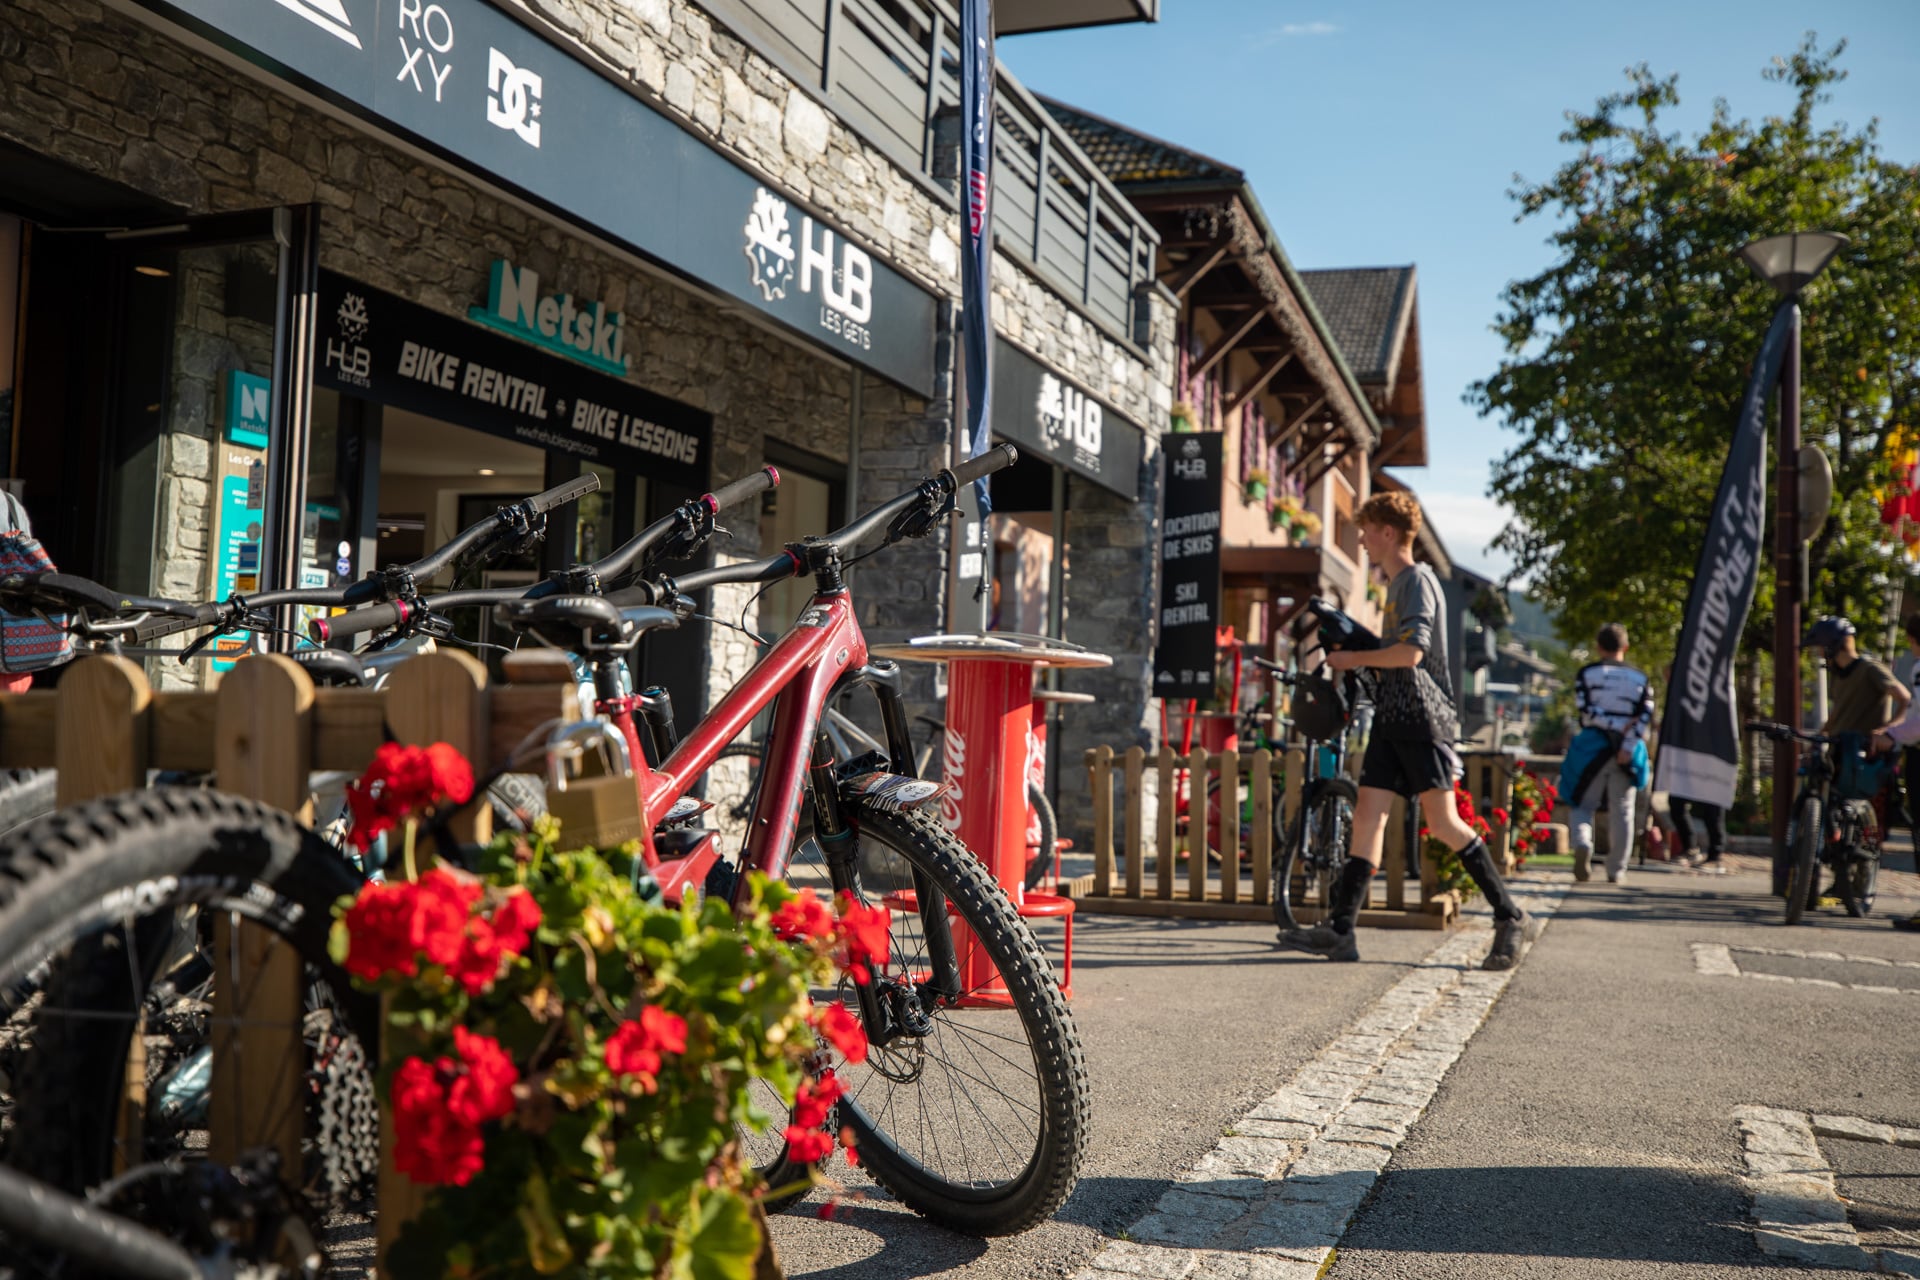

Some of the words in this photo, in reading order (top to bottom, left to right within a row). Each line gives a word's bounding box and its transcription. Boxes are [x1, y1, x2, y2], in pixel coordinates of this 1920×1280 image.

[487, 46, 542, 149] DC
[800, 216, 872, 324] HUB
[820, 306, 841, 333] LES
[843, 319, 871, 350] GETS
[325, 337, 371, 377] HUB
[337, 370, 351, 383] LES
[352, 375, 371, 389] GETS
[397, 340, 460, 391] BIKE
[461, 362, 548, 420] RENTAL
[571, 398, 619, 440] BIKE
[619, 414, 699, 464] LESSONS
[1064, 386, 1102, 455] HUB
[1163, 511, 1219, 537] OCATION
[1164, 540, 1180, 559] DE
[1183, 534, 1213, 556] SKIS
[1176, 582, 1198, 602] SKI
[1163, 602, 1209, 626] RENTAL
